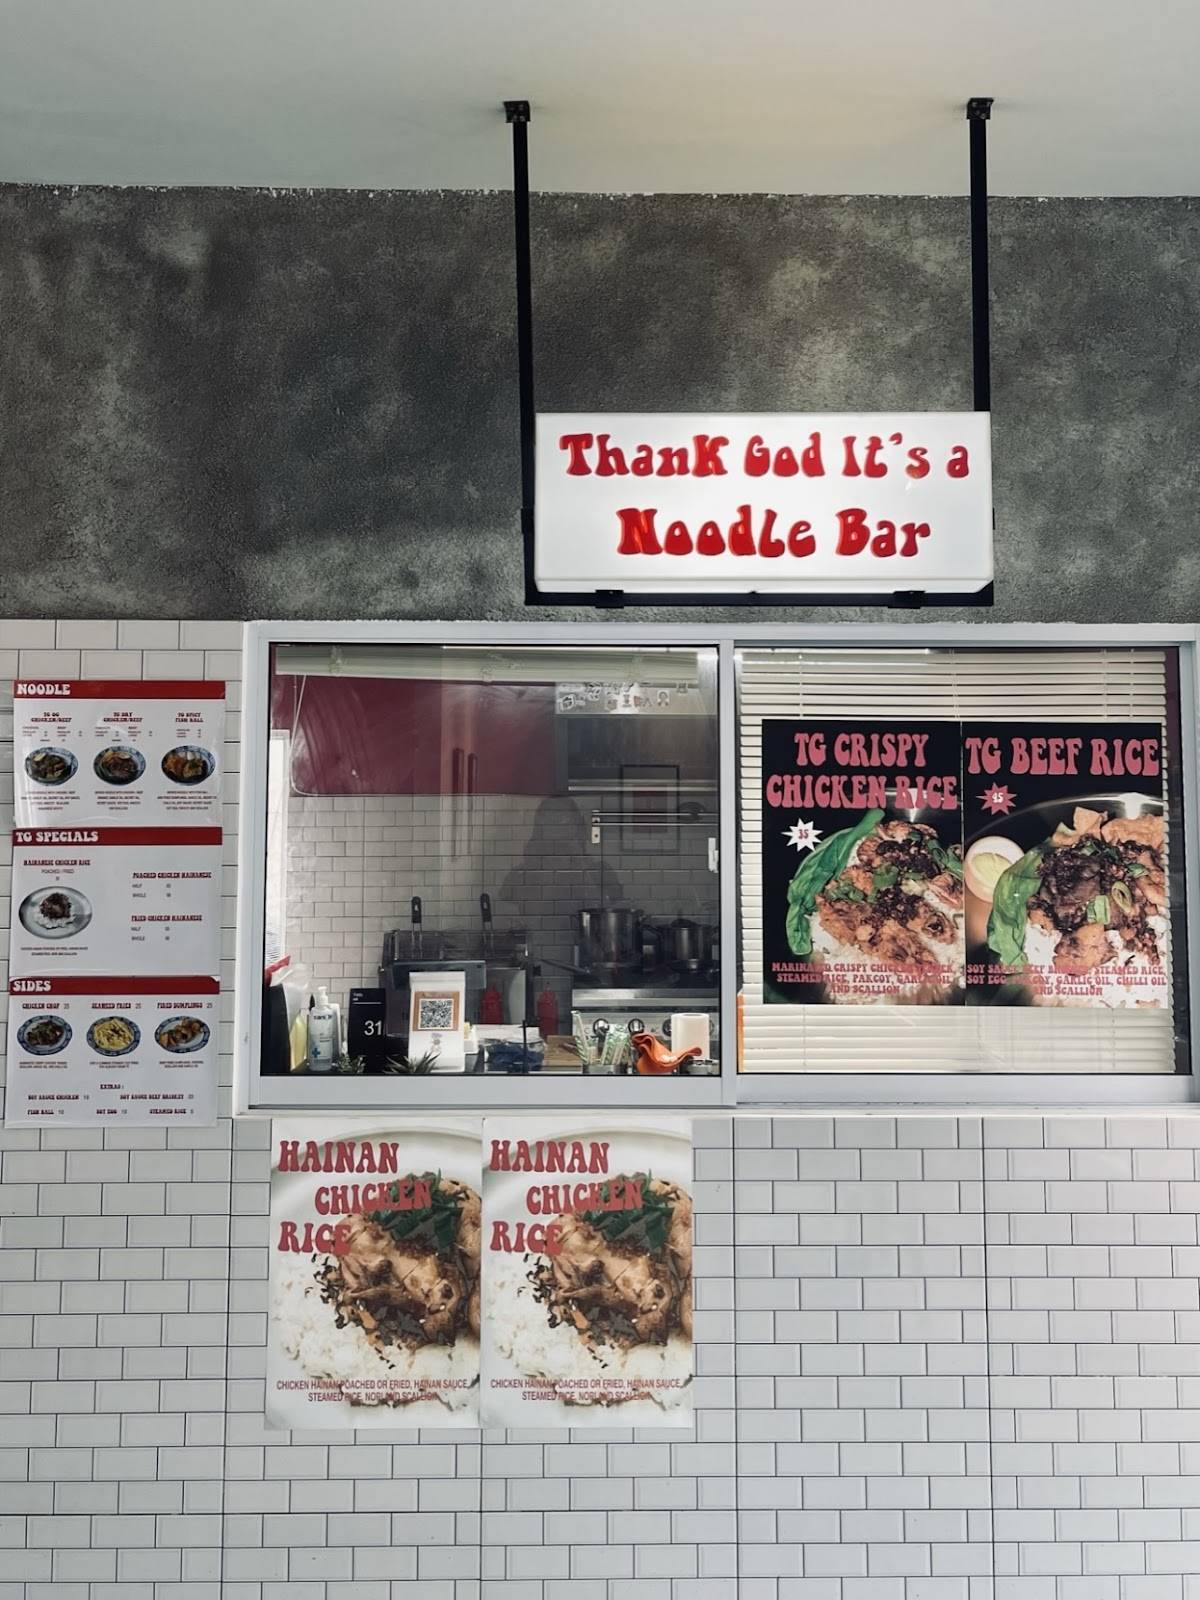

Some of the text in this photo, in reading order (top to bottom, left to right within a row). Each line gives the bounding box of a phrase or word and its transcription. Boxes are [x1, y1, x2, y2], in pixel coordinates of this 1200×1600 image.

[744, 431, 826, 479] God
[841, 432, 931, 479] It's
[946, 444, 970, 479] a
[835, 507, 932, 558] Bar
[17, 683, 71, 696] NOODLE
[795, 733, 929, 768] TG CRISPY
[965, 737, 1160, 777] TG BEEF RICE
[766, 775, 958, 810] CHICKEN RICE
[16, 831, 99, 843] TG SPECIALS
[833, 963, 868, 973] CRISPY
[967, 964, 985, 974] SOY
[1095, 966, 1138, 975] STEAMED
[853, 974, 894, 985] PAKCOY,
[967, 974, 985, 984] SOY
[1056, 975, 1092, 985] GARLIC
[1116, 975, 1148, 985] CHILLI
[1150, 975, 1167, 985] OIL
[13, 980, 51, 992] SIDES
[830, 985, 900, 994] AND SCALLION
[1055, 985, 1103, 995] SCALLION
[364, 1020, 382, 1036] 31
[278, 1140, 400, 1173] HAINAN
[489, 1140, 610, 1174] HAINAN
[314, 1177, 433, 1215] CHICKEN
[526, 1178, 644, 1215] CHICKEN
[278, 1221, 352, 1257] RICE
[490, 1221, 564, 1257] RICE
[276, 1380, 310, 1390] CHICKEN
[310, 1380, 338, 1389] HAINAN
[377, 1379, 388, 1389] OR
[414, 1379, 442, 1389] HAINAN
[490, 1379, 523, 1389] CHICKEN
[525, 1379, 552, 1389] HAINAN
[590, 1379, 600, 1389] OR
[627, 1379, 655, 1389] HAINAN
[308, 1391, 343, 1401] STEAMED
[522, 1391, 557, 1401] STEAMED
